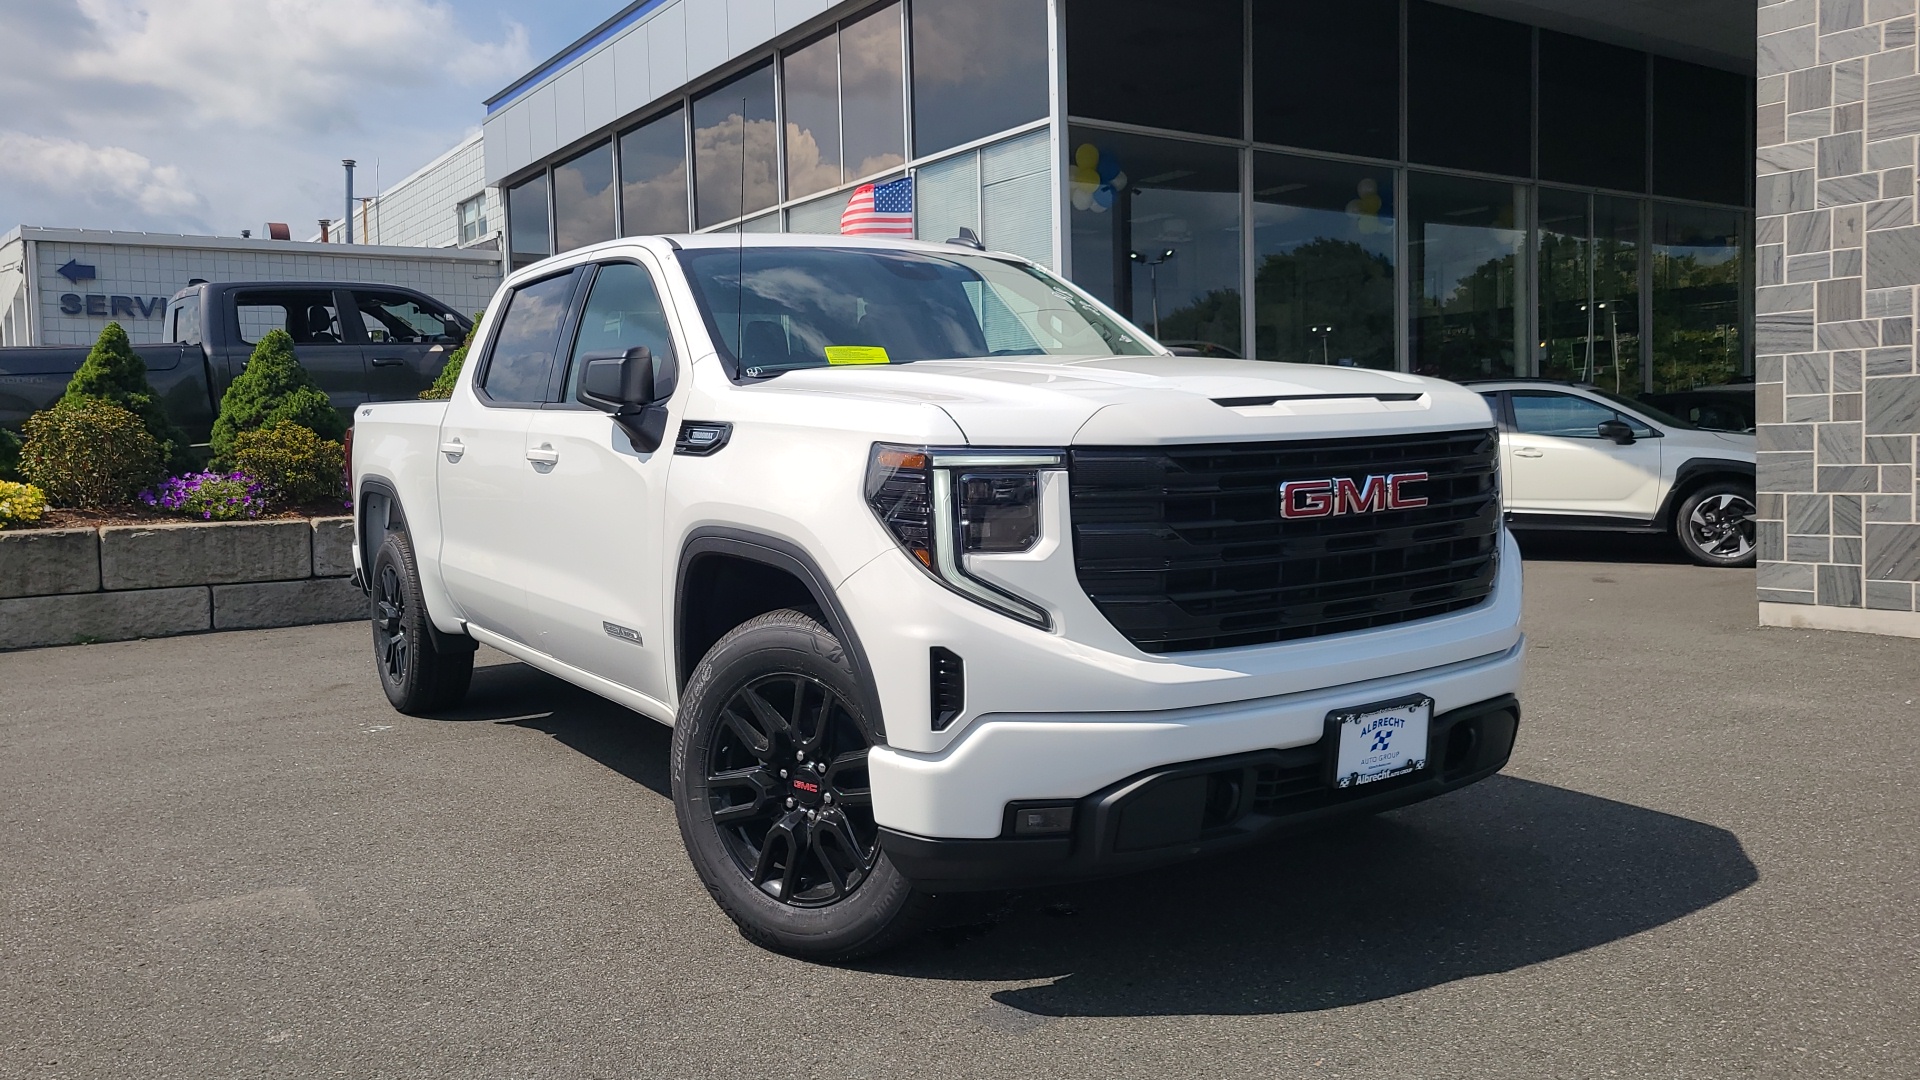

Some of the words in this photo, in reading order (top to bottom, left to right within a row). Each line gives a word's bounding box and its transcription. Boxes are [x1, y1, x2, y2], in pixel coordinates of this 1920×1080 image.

[1280, 472, 1428, 519] GMC
[1360, 717, 1406, 738] ALBRECHT
[1360, 756, 1378, 765] AUTO
[1378, 751, 1400, 762] GROUP
[1356, 769, 1391, 785] Albrecht
[793, 780, 818, 793] GMC
